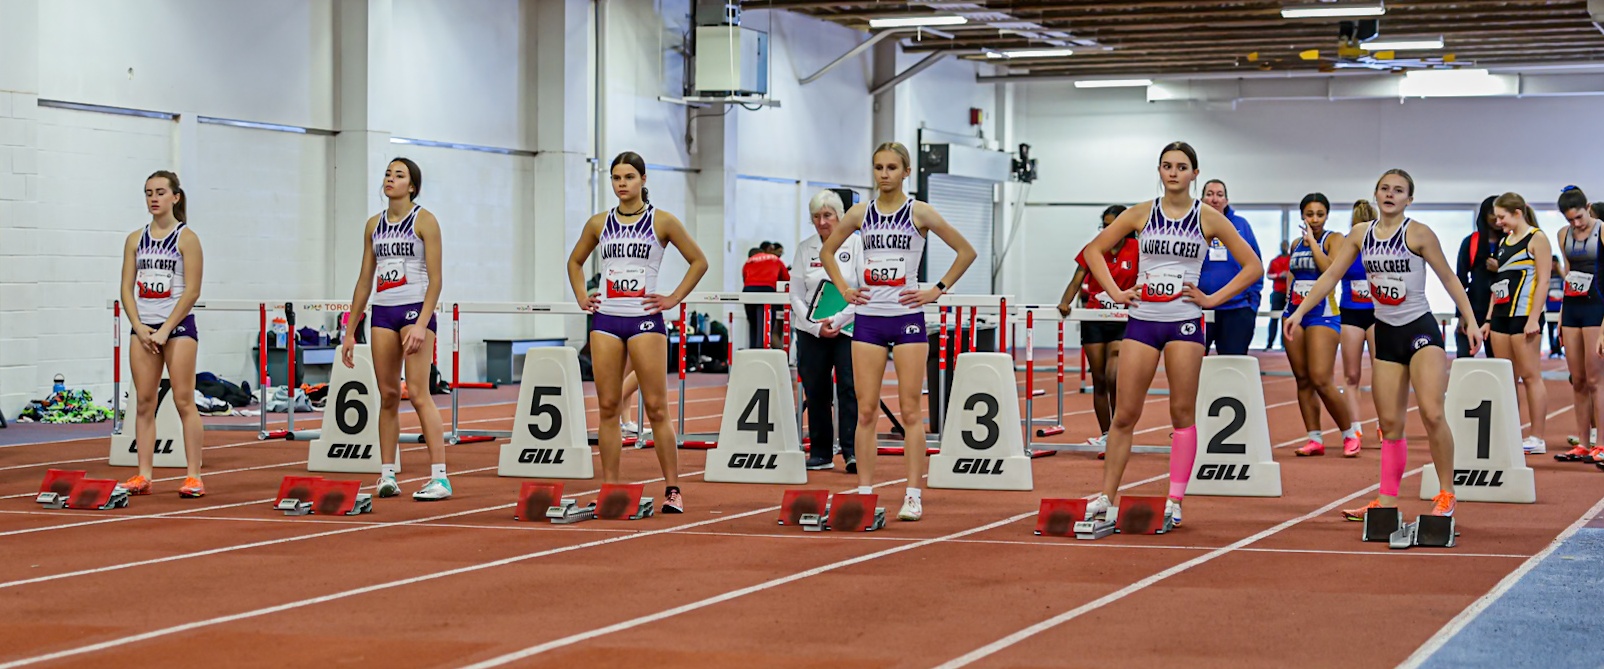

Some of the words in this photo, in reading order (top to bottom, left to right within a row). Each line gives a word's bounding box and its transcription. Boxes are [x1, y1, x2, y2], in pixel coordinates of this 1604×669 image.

[391, 242, 415, 257] CREEK
[886, 234, 912, 250] CREEK
[1141, 238, 1170, 255] LAUREL
[1172, 241, 1201, 259] CREEK
[627, 243, 652, 260] CREEK
[1383, 258, 1412, 273] CREEK
[871, 267, 898, 282] 687
[142, 281, 164, 294] 310
[612, 279, 639, 292] 402
[1147, 282, 1175, 296] 609
[1375, 285, 1399, 300] 476
[335, 381, 369, 435] 6
[527, 386, 563, 441] 5
[736, 388, 775, 444] 4
[961, 392, 1000, 450] 3
[1206, 396, 1247, 454] 2
[1464, 400, 1492, 459] 1
[327, 443, 373, 460] GILL
[517, 448, 565, 464] GILL
[727, 453, 778, 470] GILL
[952, 458, 1004, 475] GILL
[1196, 464, 1251, 481] GILL
[1453, 469, 1504, 487] GILL
